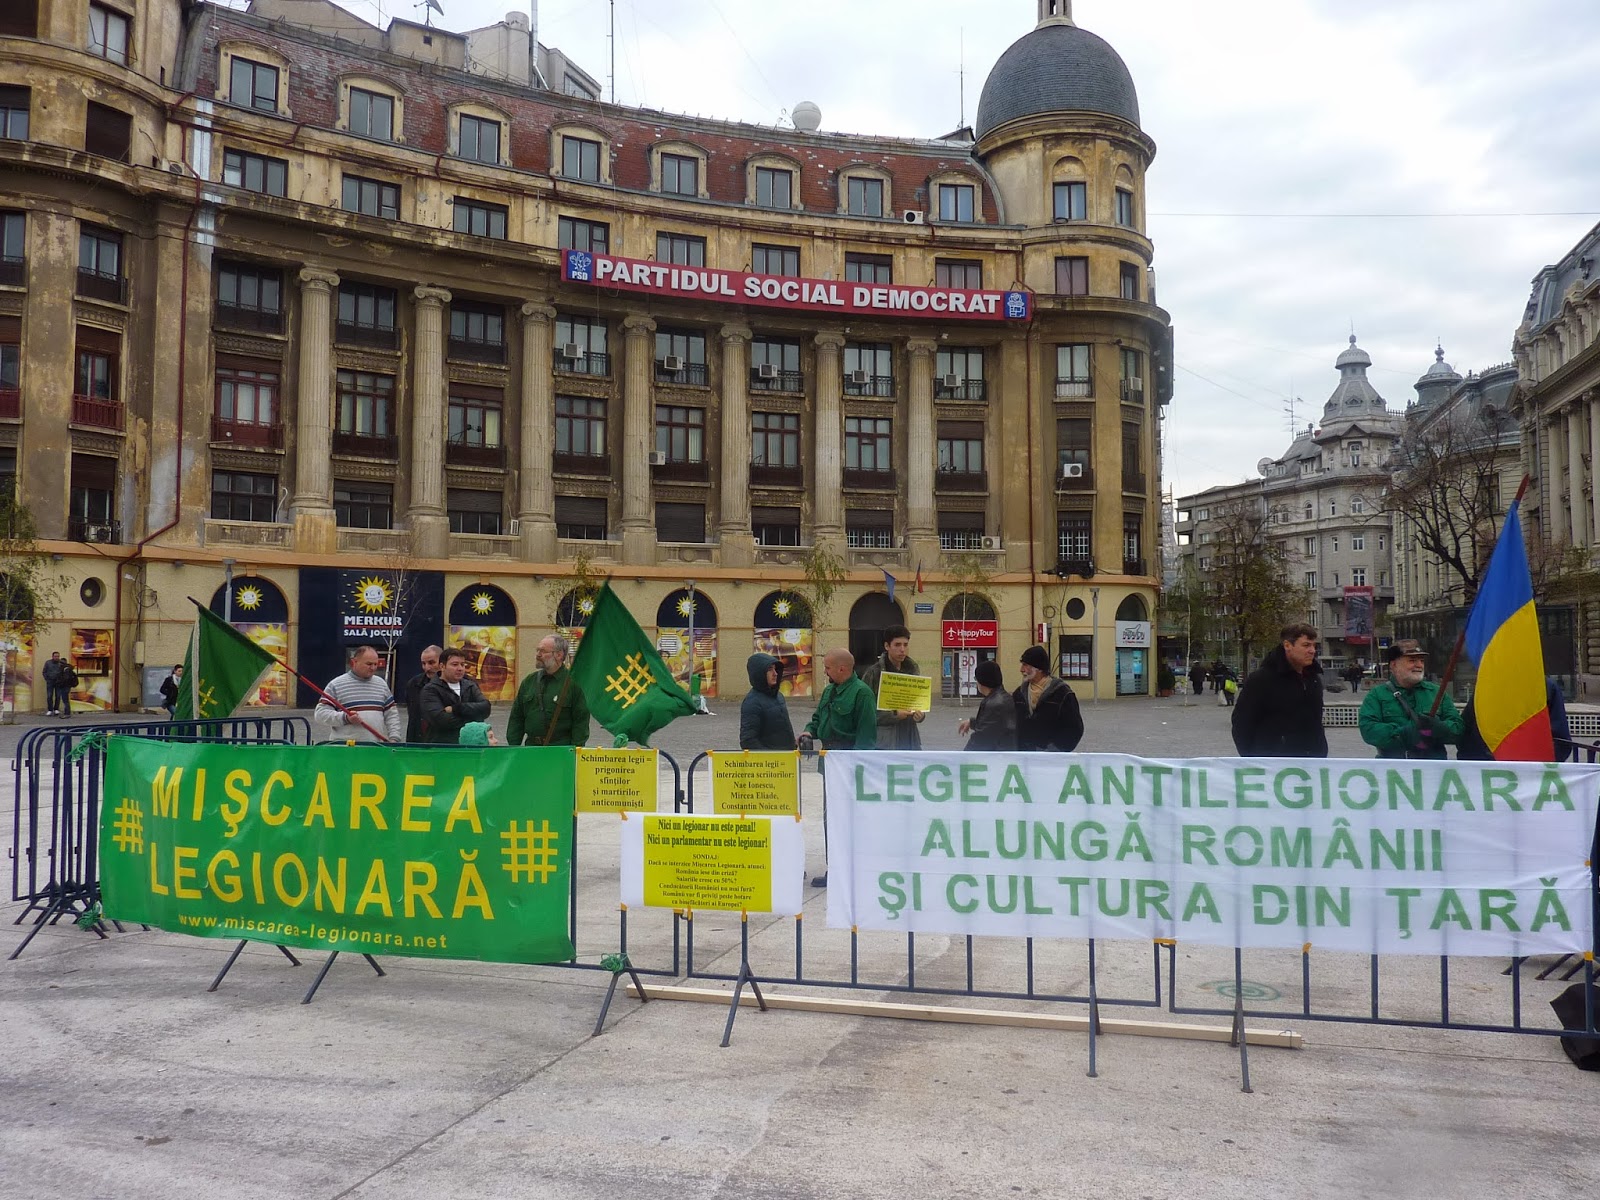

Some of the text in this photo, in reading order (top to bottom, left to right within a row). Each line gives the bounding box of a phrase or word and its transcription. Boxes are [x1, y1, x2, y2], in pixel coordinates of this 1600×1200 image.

[571, 270, 588, 281] PSD
[596, 258, 1000, 314] PARTIDUL SOCIAL DEMOCRAT
[344, 615, 403, 626] MERKUR
[343, 628, 403, 638] SALĂ JOCURI
[581, 754, 626, 763] Schimbarea
[628, 755, 645, 764] legii
[724, 760, 764, 768] Schimbarea
[765, 760, 779, 769] legii
[595, 766, 635, 775] prigonirea
[756, 771, 795, 779] scriitorilor:
[733, 781, 776, 790] Nae Ionescu,
[854, 763, 1576, 812] LEGEA ANTILEGIONARĂ
[601, 788, 640, 796] martirilor
[730, 792, 754, 800] Mircea
[721, 802, 791, 811] Constantin Noica etc.
[658, 819, 756, 835] Nici un legionar nu este penal!
[647, 833, 768, 850] Nici un parlamentar nu este legionar!
[920, 812, 1445, 872] ALUNGĂ ROMÂNII
[150, 842, 494, 920] LEGIONARĂ
[945, 872, 1222, 925] CULTURA
[1252, 883, 1352, 927] DIN
[178, 913, 448, 950] www.miscarea-legionara.net
